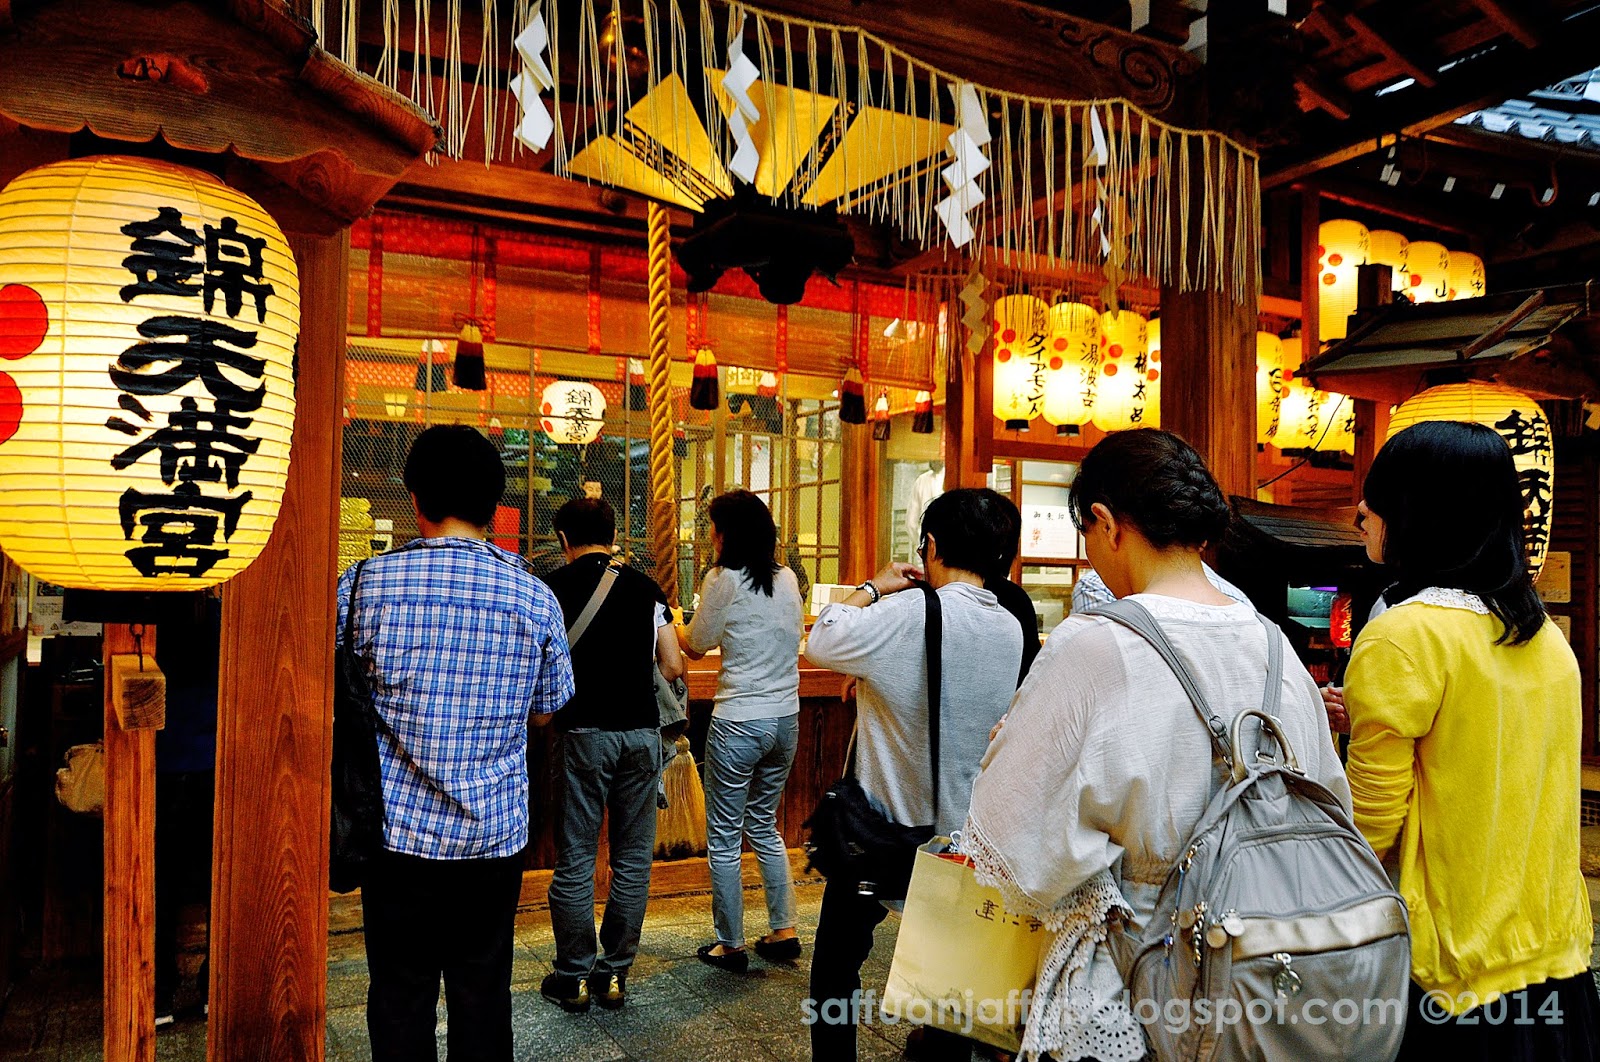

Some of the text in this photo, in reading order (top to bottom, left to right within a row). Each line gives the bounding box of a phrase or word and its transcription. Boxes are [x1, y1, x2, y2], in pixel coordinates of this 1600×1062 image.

[105, 206, 276, 579] 錦天満宮
[1027, 332, 1048, 416] ダイアモンド
